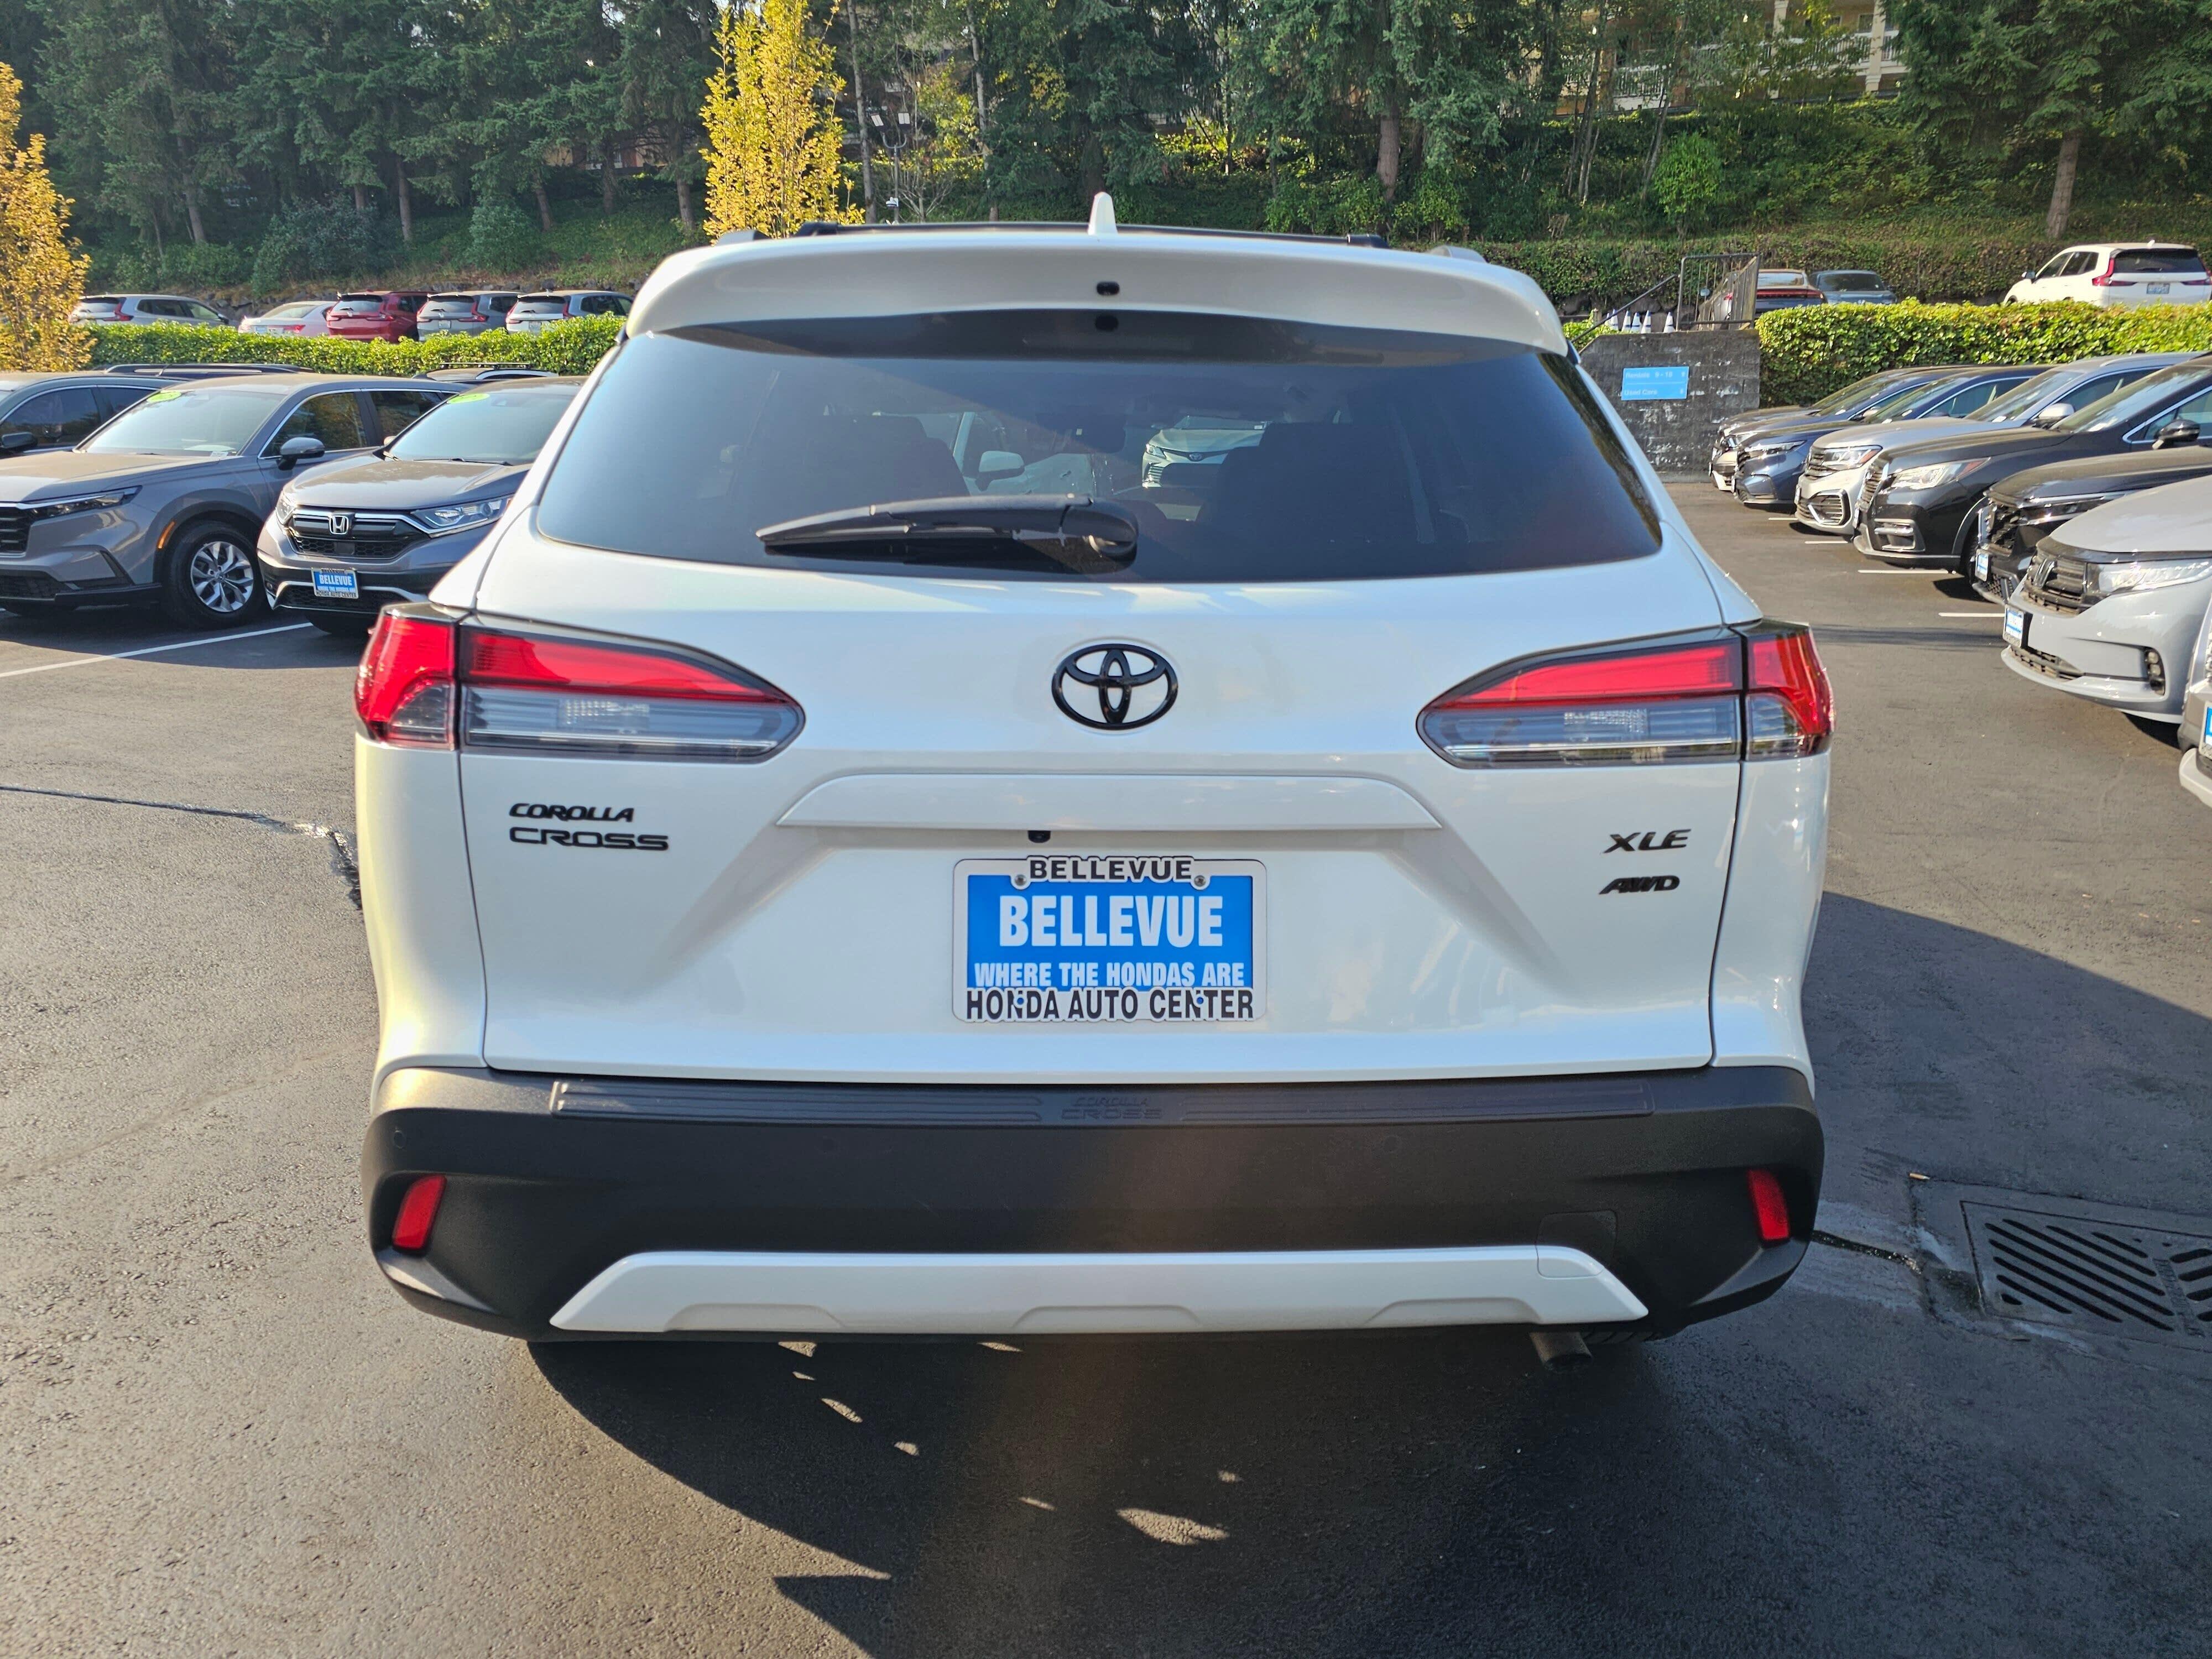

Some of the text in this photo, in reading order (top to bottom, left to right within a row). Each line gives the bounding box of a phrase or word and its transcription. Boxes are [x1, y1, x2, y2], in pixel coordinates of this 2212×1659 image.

[319, 575, 352, 586] BELLEVUE
[509, 803, 634, 822] COROLLA
[509, 827, 669, 851] CROSS
[1603, 829, 1692, 853] XLE
[1030, 860, 1191, 880] BELLEVUE
[1599, 875, 1680, 895] AWD
[999, 895, 1223, 948] BELLEVUE
[974, 961, 1244, 987] WHERE THE HONDAS ARE
[967, 989, 1253, 1019] HONDA AUTO CENTER
[1061, 1109, 1162, 1120] CROSS
